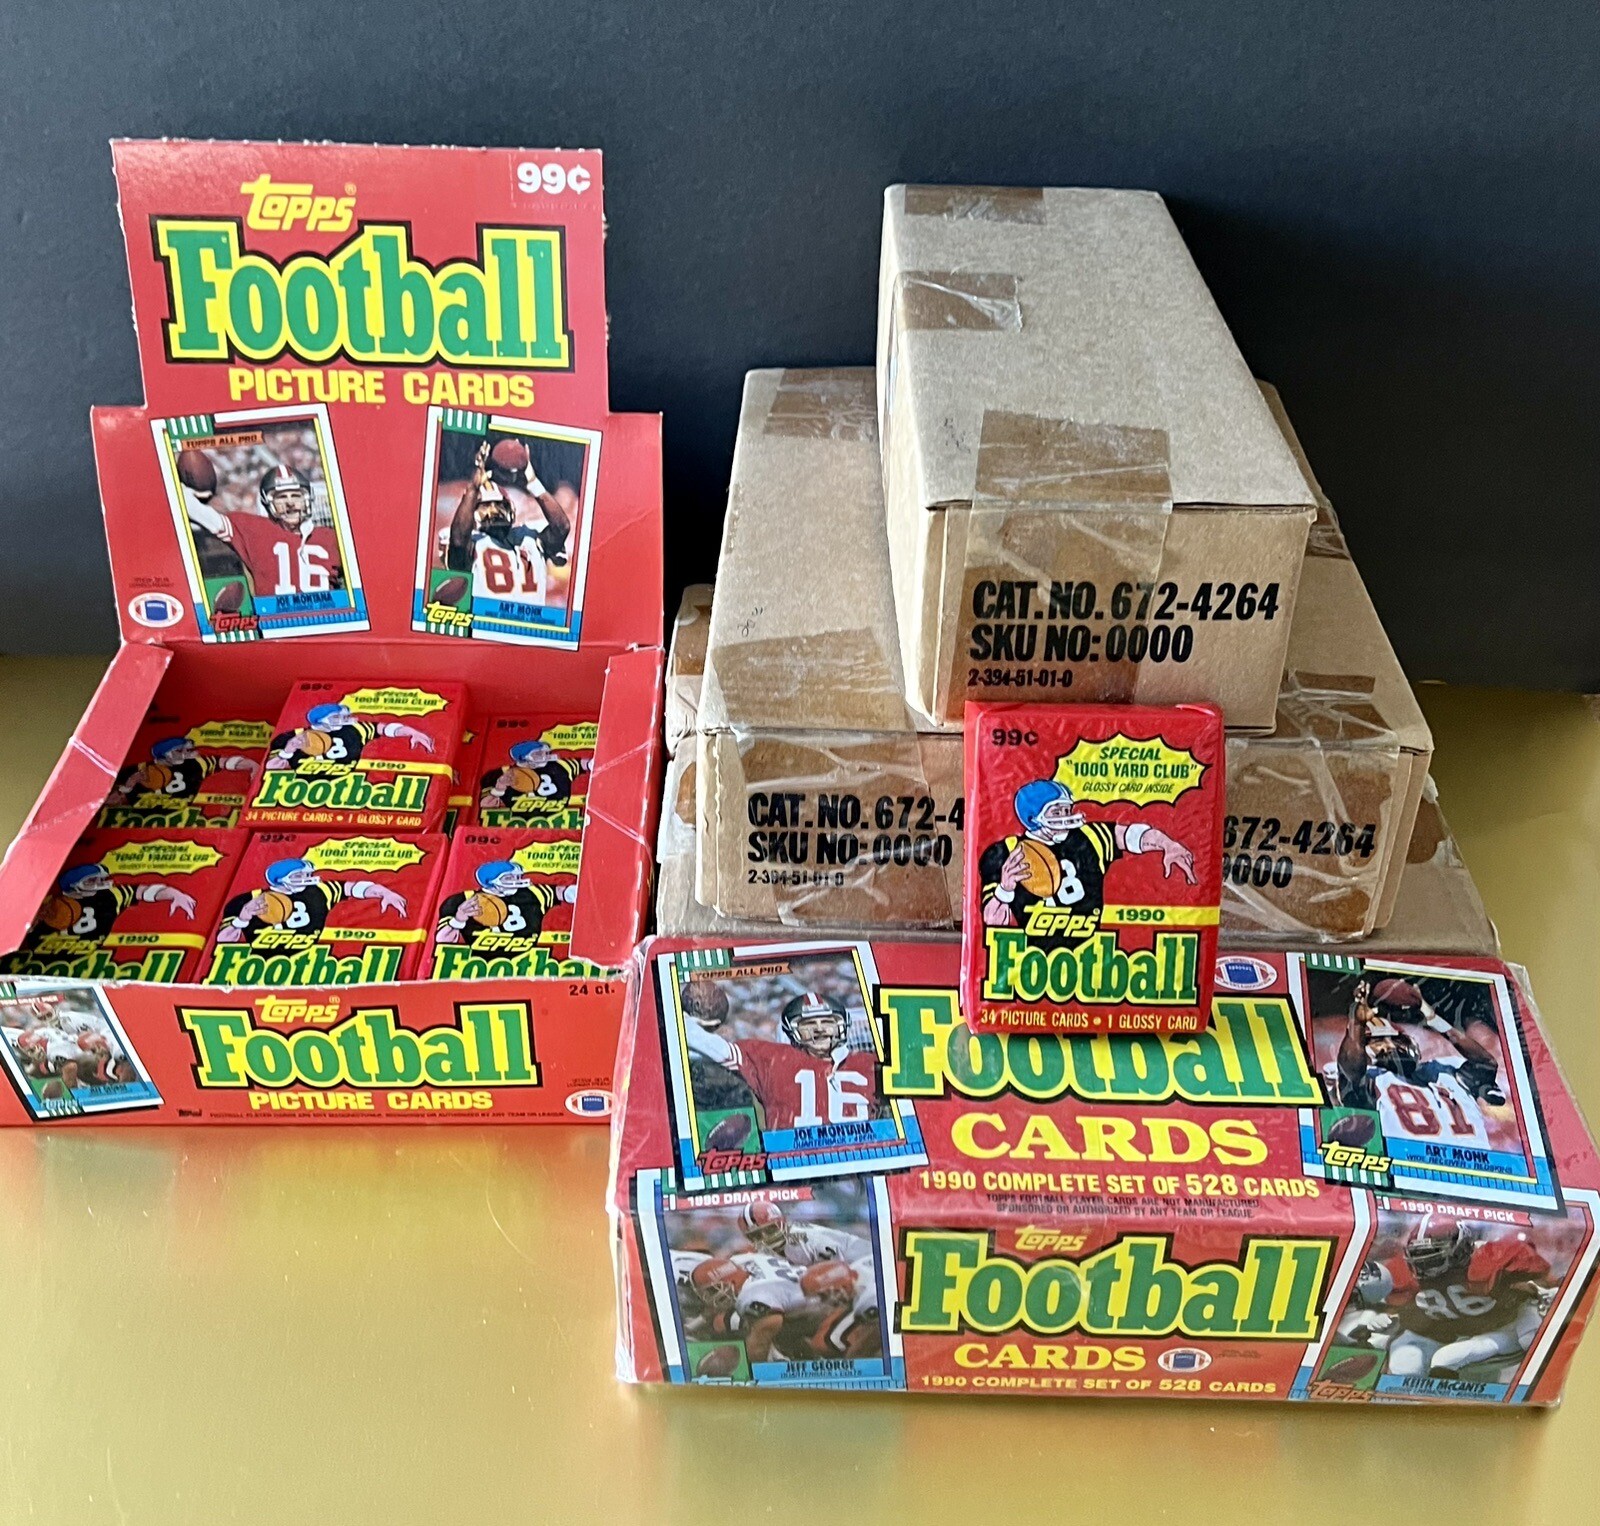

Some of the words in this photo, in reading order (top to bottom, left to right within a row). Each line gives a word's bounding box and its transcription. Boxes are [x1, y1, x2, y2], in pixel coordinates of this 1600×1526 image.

[517, 162, 591, 195] 99¢
[157, 219, 569, 367] Football
[229, 368, 386, 403] PICTURE
[403, 374, 534, 408] CARDS
[219, 437, 234, 446] ALL
[273, 541, 330, 596] 16
[483, 547, 538, 594] 81
[1111, 581, 1280, 621] 672-4264
[969, 624, 1038, 662] SKU
[1105, 624, 1194, 663] 0000
[991, 728, 1039, 747] 99¢
[1099, 746, 1162, 761] SPECIAL
[1114, 762, 1152, 778] YARD
[252, 769, 431, 812] Football
[1082, 780, 1118, 794] GLOSSY
[1119, 781, 1143, 794] CARD
[1144, 782, 1175, 795] INSIDE
[261, 811, 299, 822] PICTURE
[302, 812, 334, 823] CARDS
[356, 814, 394, 825] GLOSSY
[396, 815, 422, 827] CARD
[875, 795, 965, 831] 672-4
[748, 830, 809, 864] SKU
[872, 833, 953, 867] 0000
[1115, 908, 1166, 922] 1990
[333, 930, 376, 939] 1990
[551, 933, 571, 942] 19
[203, 943, 403, 986] Football
[735, 968, 758, 976] ALL
[984, 927, 1199, 1005] Football
[569, 983, 589, 996] 24
[981, 1008, 998, 1024] 34
[1000, 1010, 1047, 1027] PICTURE
[1052, 1011, 1089, 1028] CARDS
[1119, 1013, 1163, 1029] GLOSSY
[1167, 1014, 1197, 1031] CARD
[184, 1000, 538, 1089] Football
[248, 1090, 374, 1110] PICTURE
[386, 1091, 493, 1110] CARDS
[793, 1069, 870, 1128] 16
[1385, 1082, 1478, 1139] 81
[793, 1126, 814, 1139] JOE
[817, 1122, 874, 1138] MONTANA
[951, 1112, 1268, 1166] CARDS
[1425, 1144, 1451, 1158] ART
[1452, 1147, 1490, 1164] MONK
[919, 1170, 977, 1190] 1990
[983, 1171, 1101, 1193] COMPLETE
[1105, 1174, 1147, 1195] SET
[1152, 1175, 1181, 1195] OF
[1185, 1173, 1239, 1196] 528
[1243, 1177, 1320, 1198] CARDS
[723, 1191, 766, 1205] DRAFT
[768, 1189, 800, 1201] PICK
[1107, 1196, 1139, 1206] CARDS
[1149, 1207, 1169, 1217] ANY
[1172, 1207, 1198, 1217] TEAM
[1399, 1200, 1433, 1214] 1990
[1437, 1205, 1481, 1218] DRAFT
[1483, 1210, 1515, 1222] PICK
[903, 1231, 1331, 1341] Football
[811, 1359, 856, 1372] GEORGE
[954, 1342, 1146, 1372] CARDS
[921, 1374, 967, 1387] 1990
[972, 1375, 1077, 1390] COMPLETE
[1082, 1376, 1121, 1390] SET
[1125, 1379, 1152, 1390] OF
[1158, 1378, 1202, 1392] 528
[1208, 1381, 1277, 1394] CARDS
